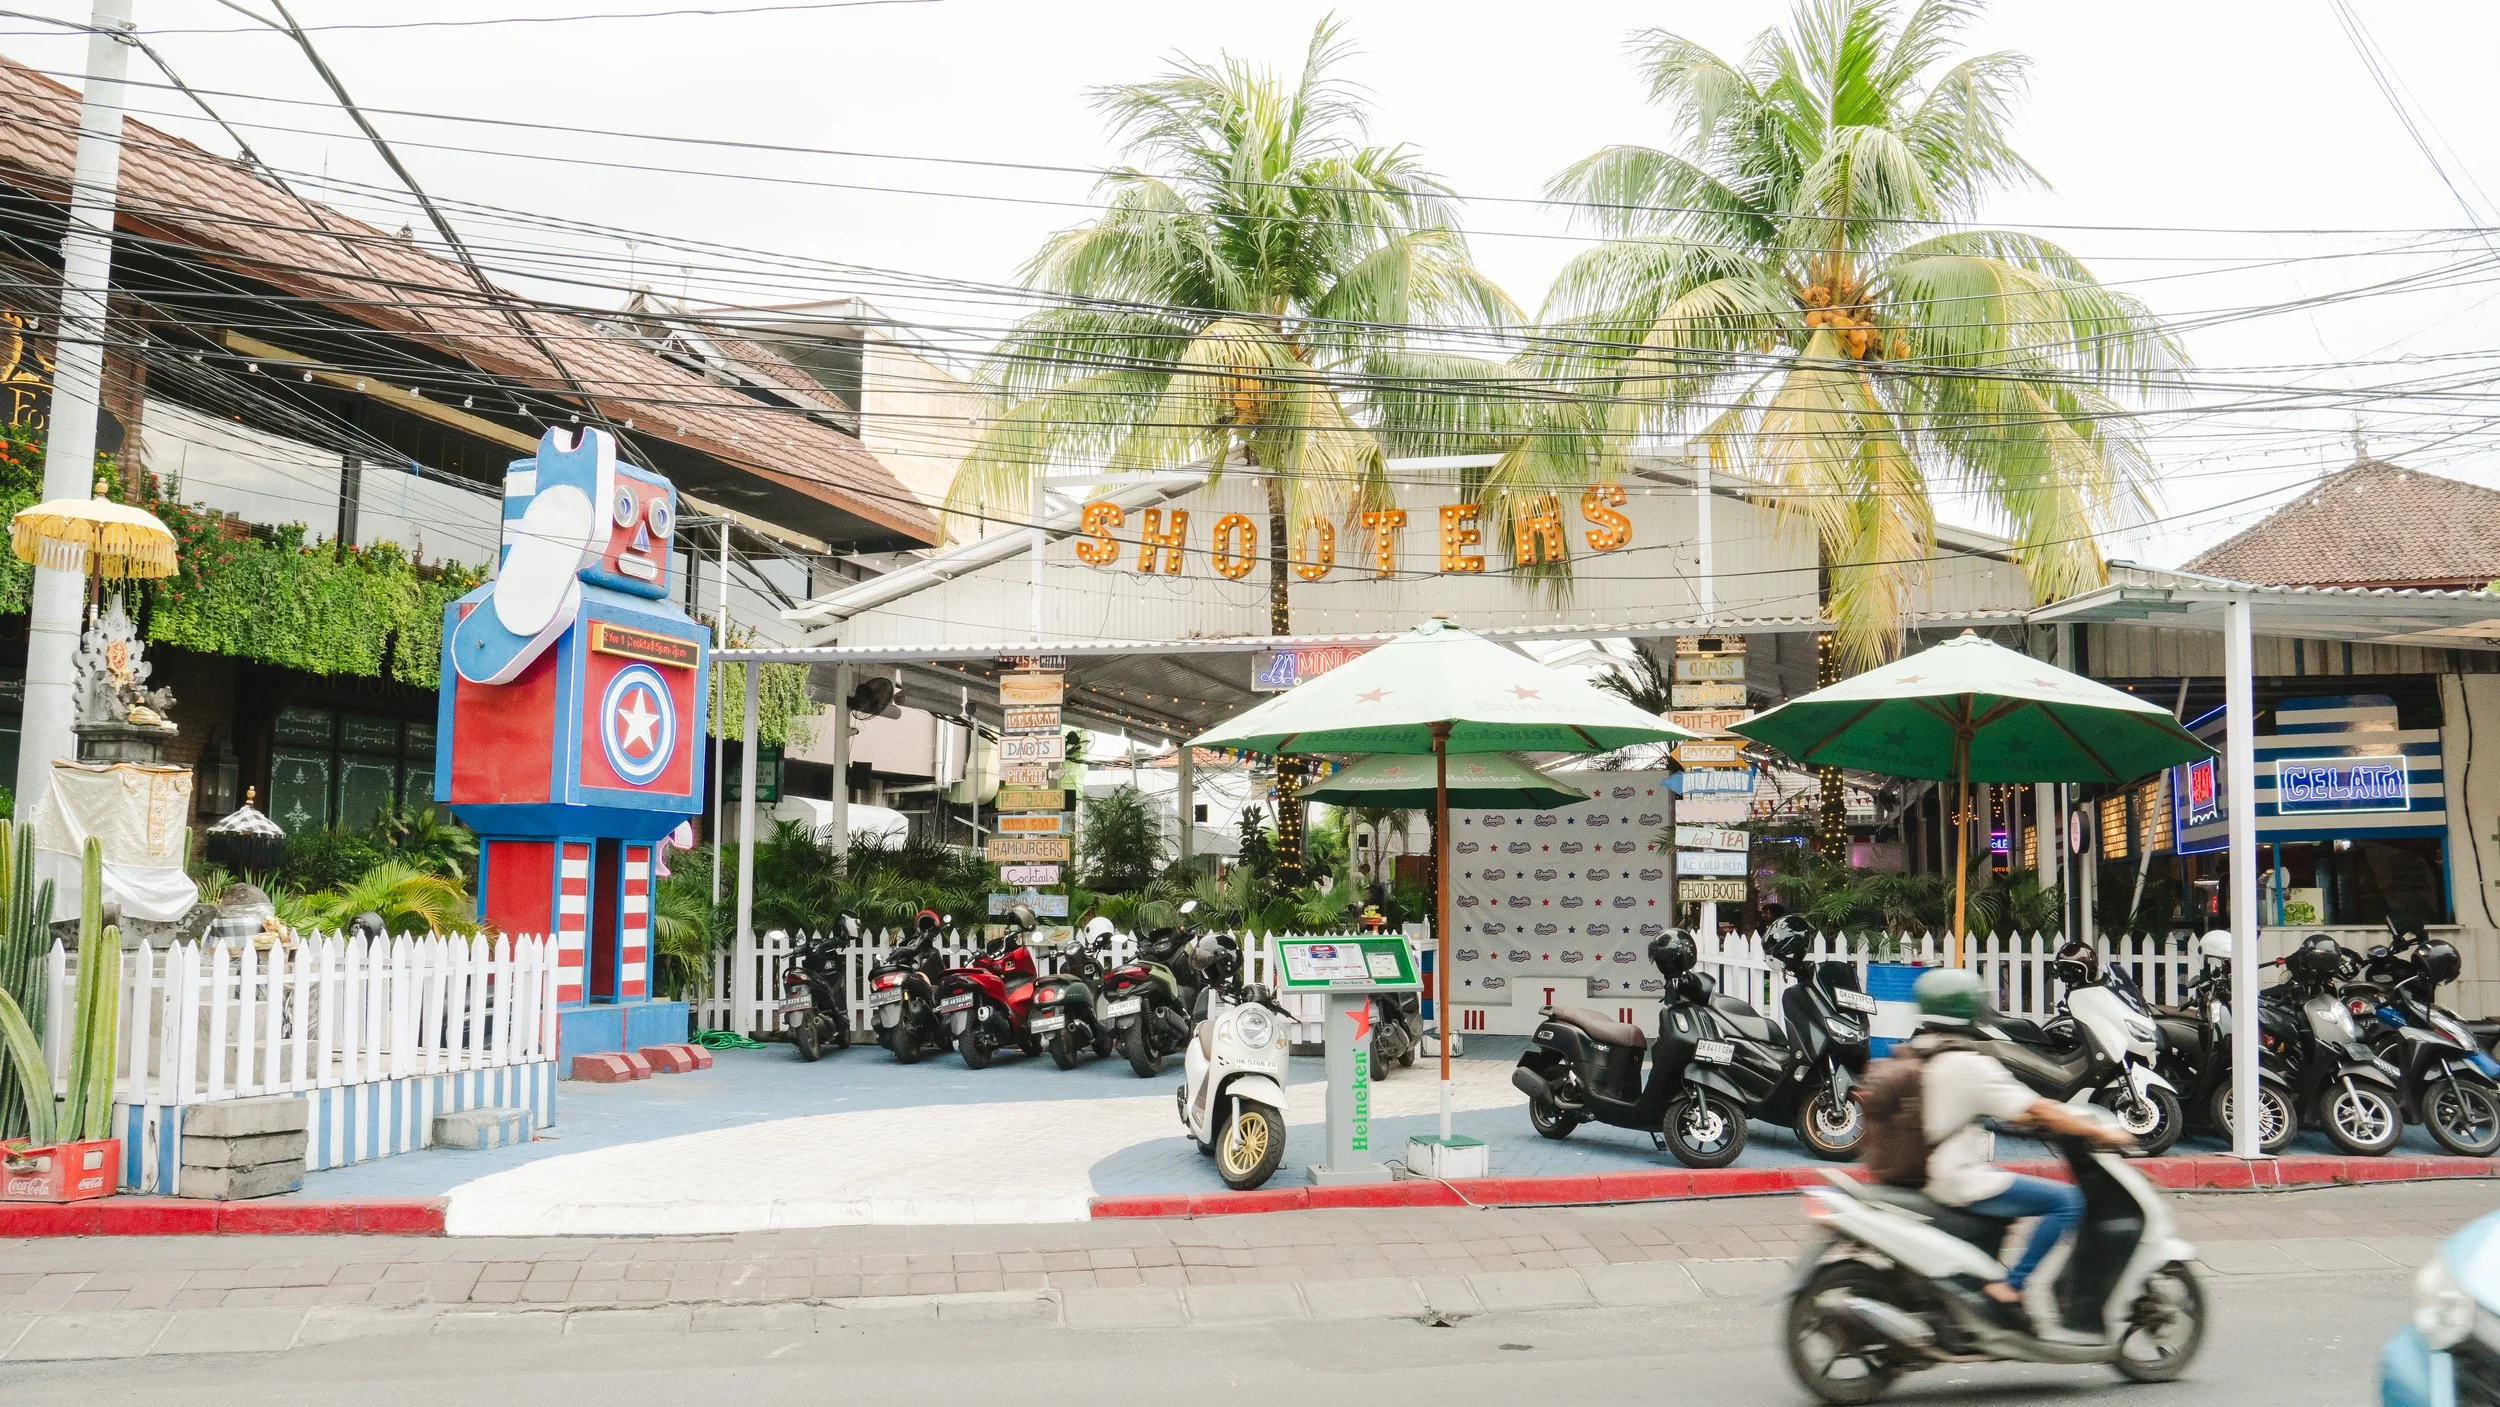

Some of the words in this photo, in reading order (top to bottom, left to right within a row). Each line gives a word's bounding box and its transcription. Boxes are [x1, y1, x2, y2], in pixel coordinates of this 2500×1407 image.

[1075, 483, 1633, 582] SHOOTERS
[603, 631, 609, 642] 2
[1297, 650, 1343, 675] MINI
[1689, 660, 1735, 676] GAMES
[1007, 715, 1024, 728] ICE
[1025, 713, 1058, 727] CREAM
[1007, 740, 1050, 756] DARTS
[1348, 775, 1421, 786] Heineken
[2284, 764, 2404, 802] GELATO
[1691, 831, 1714, 846] Iced
[1720, 831, 1744, 848] TEA
[993, 841, 1064, 858] HAMBURGERS
[1007, 867, 1055, 883] Cocktails
[1680, 882, 1710, 899] PHOTO
[1712, 882, 1745, 900] BOOTH
[1352, 1051, 1369, 1151] Heineken
